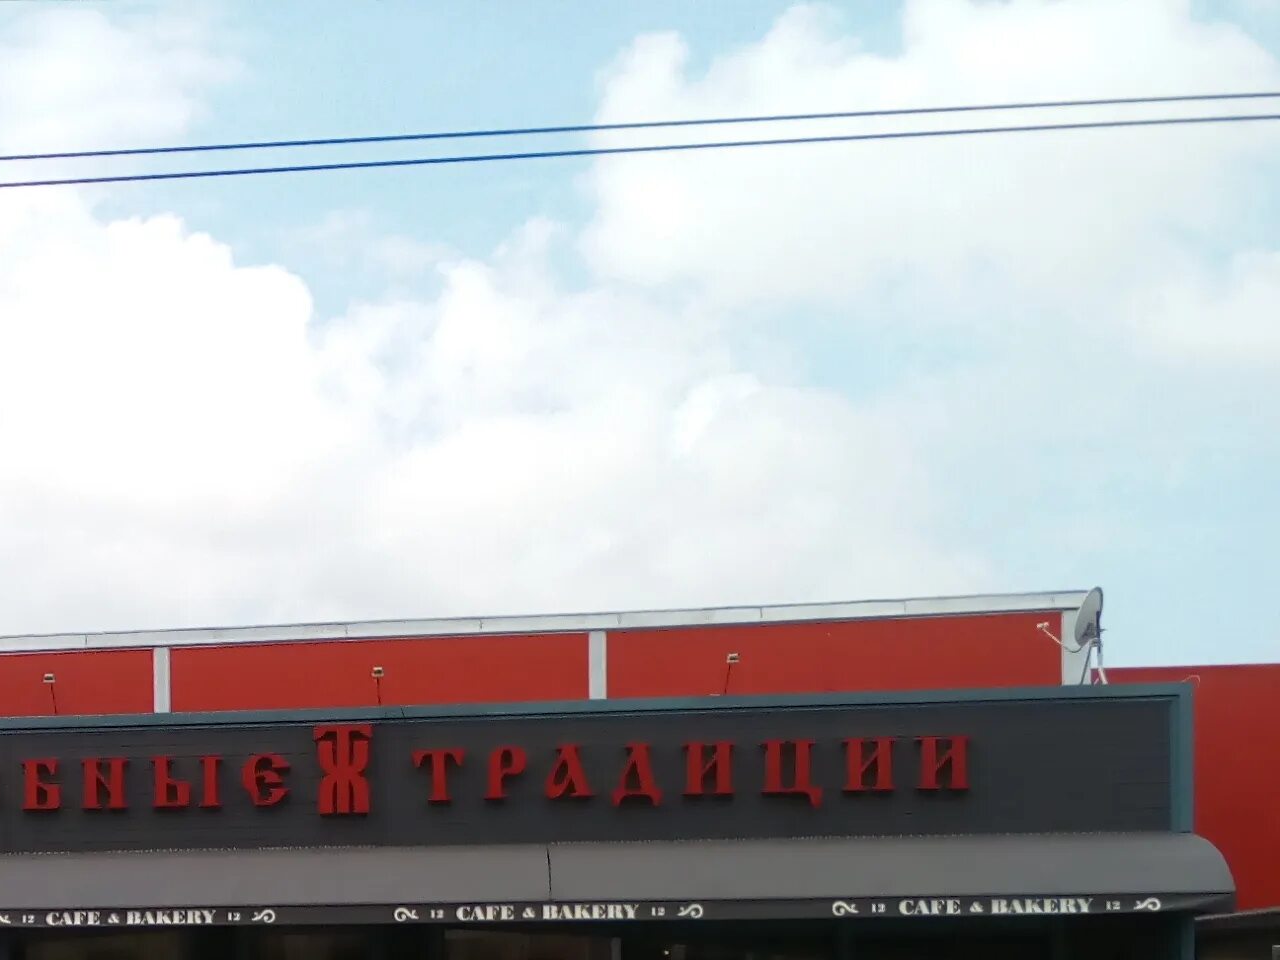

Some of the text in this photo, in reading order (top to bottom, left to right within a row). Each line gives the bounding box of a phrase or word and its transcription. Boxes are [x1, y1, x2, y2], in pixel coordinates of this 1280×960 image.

[411, 735, 972, 808] ТРАДИЦИИ
[455, 905, 515, 921] CAFE
[522, 906, 535, 918] &
[542, 904, 640, 920] BAKERY
[898, 899, 961, 915] CAFE
[970, 901, 984, 912] &
[991, 898, 1094, 914] BAKERY
[45, 911, 101, 926] CAFE
[107, 912, 120, 924] &
[125, 909, 217, 926] BAKERY
